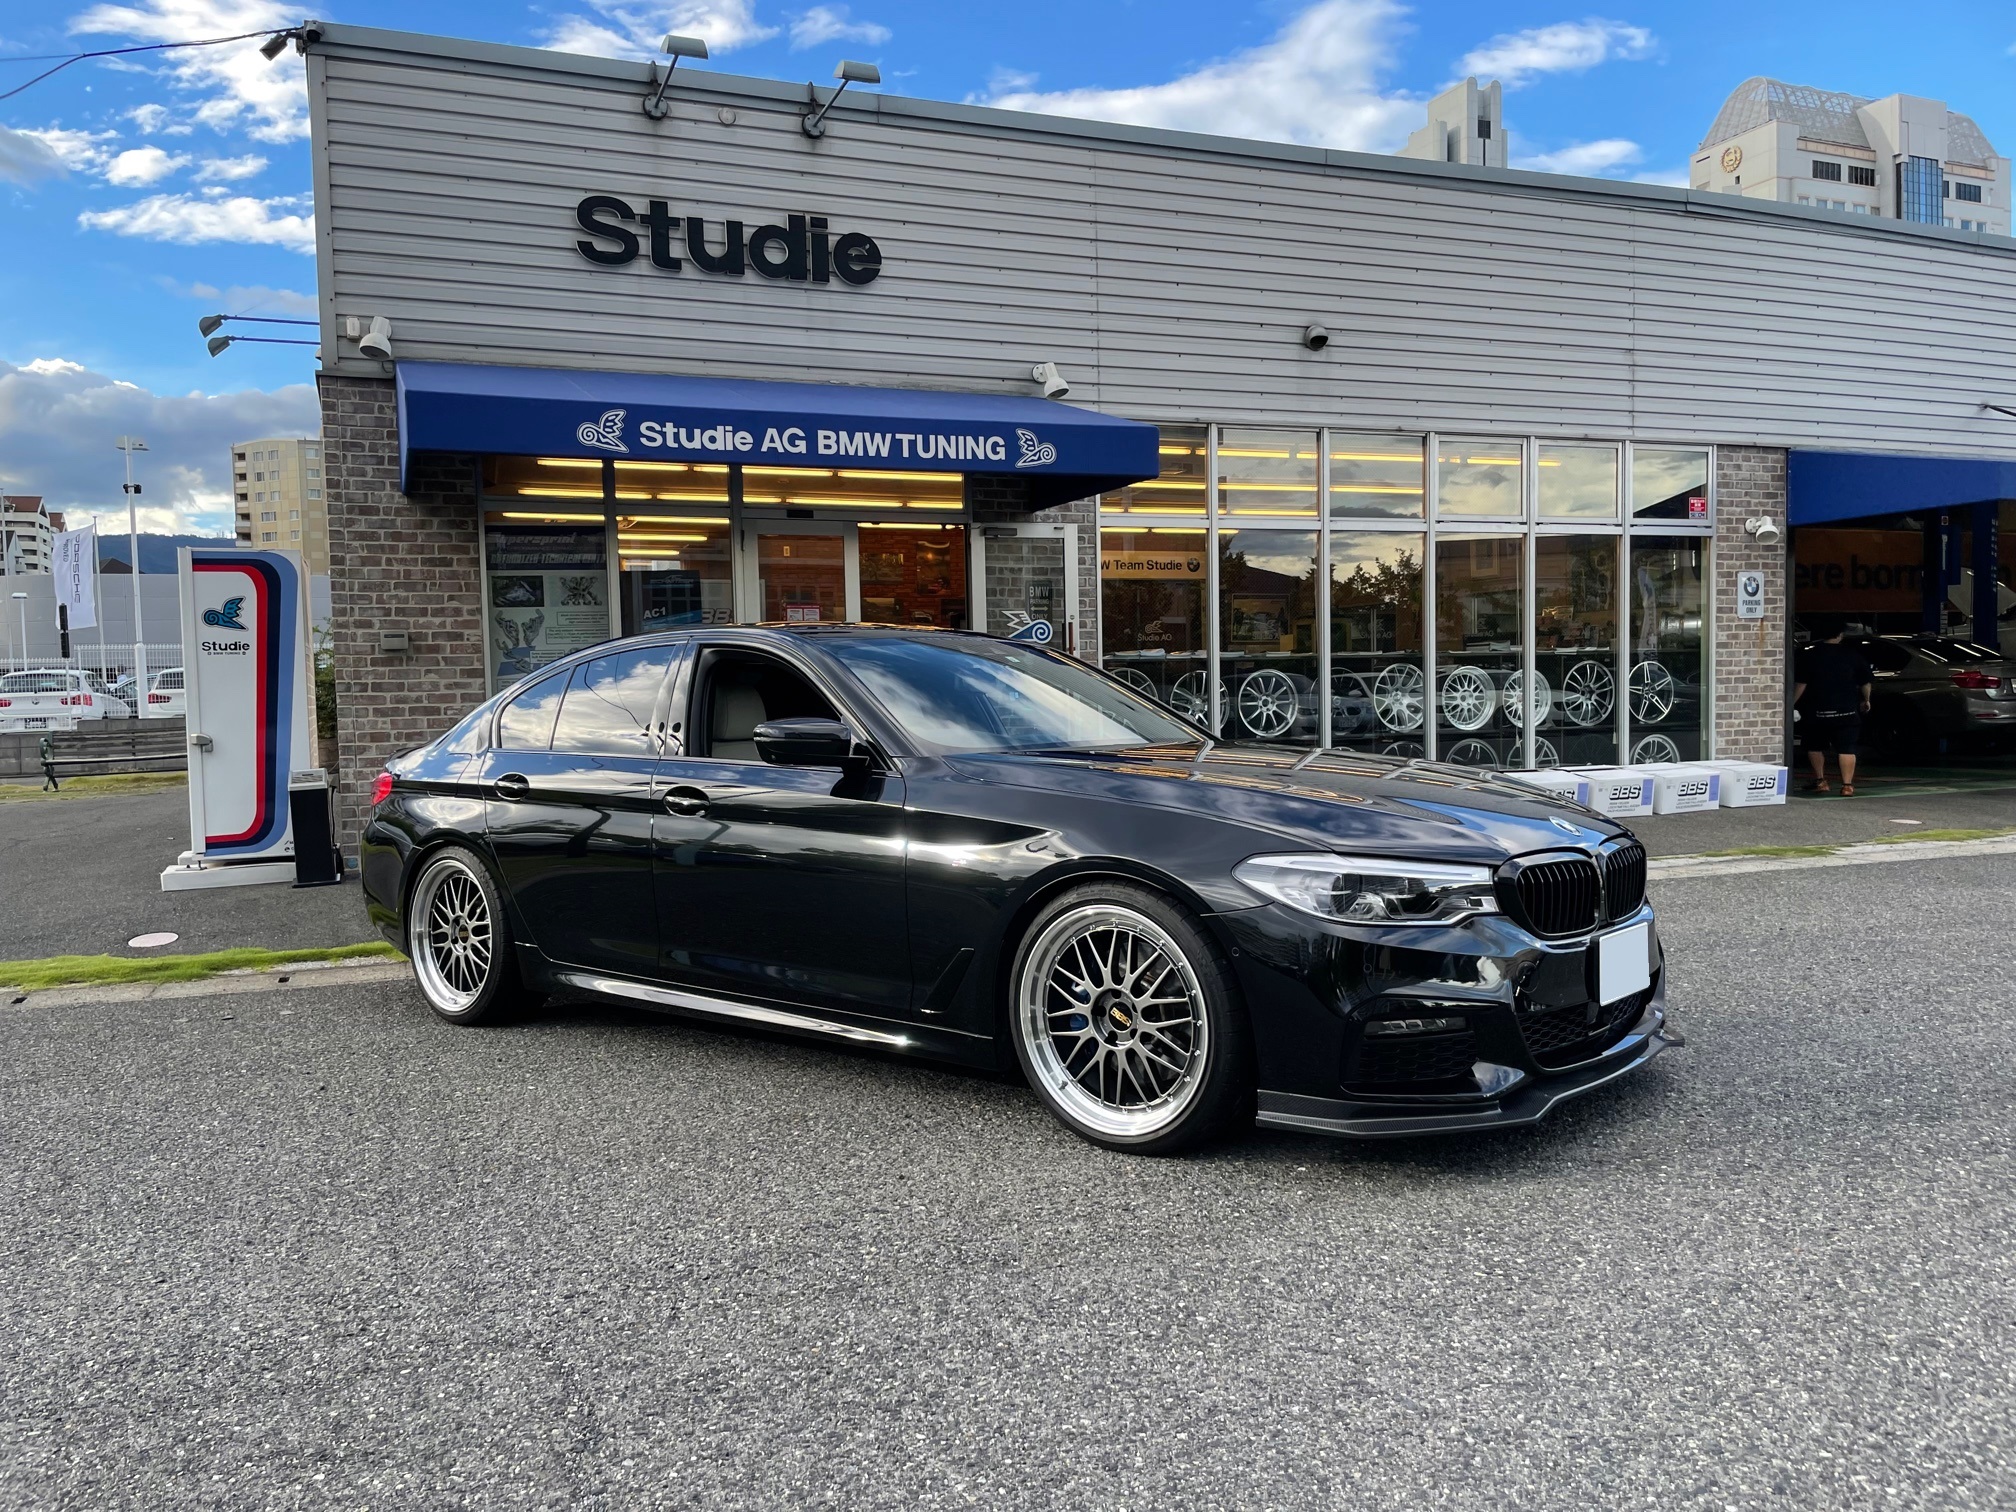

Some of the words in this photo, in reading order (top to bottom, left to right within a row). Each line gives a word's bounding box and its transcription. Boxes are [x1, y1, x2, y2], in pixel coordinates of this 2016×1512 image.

[575, 195, 882, 287] Studie
[639, 421, 754, 451] Studie
[760, 427, 807, 454] AG
[817, 429, 892, 457] BMW
[895, 433, 1006, 461] TUNING
[73, 534, 81, 603] PORSCHE
[1114, 560, 1144, 570] Team
[1146, 559, 1183, 571] Studie
[1030, 586, 1049, 597] BMW
[643, 607, 666, 619] AC1
[201, 641, 250, 652] Studie
[1677, 780, 1708, 797] BBS
[1747, 774, 1776, 791] BBS
[1609, 784, 1641, 800] BBS
[1110, 1006, 1132, 1027] BBS
